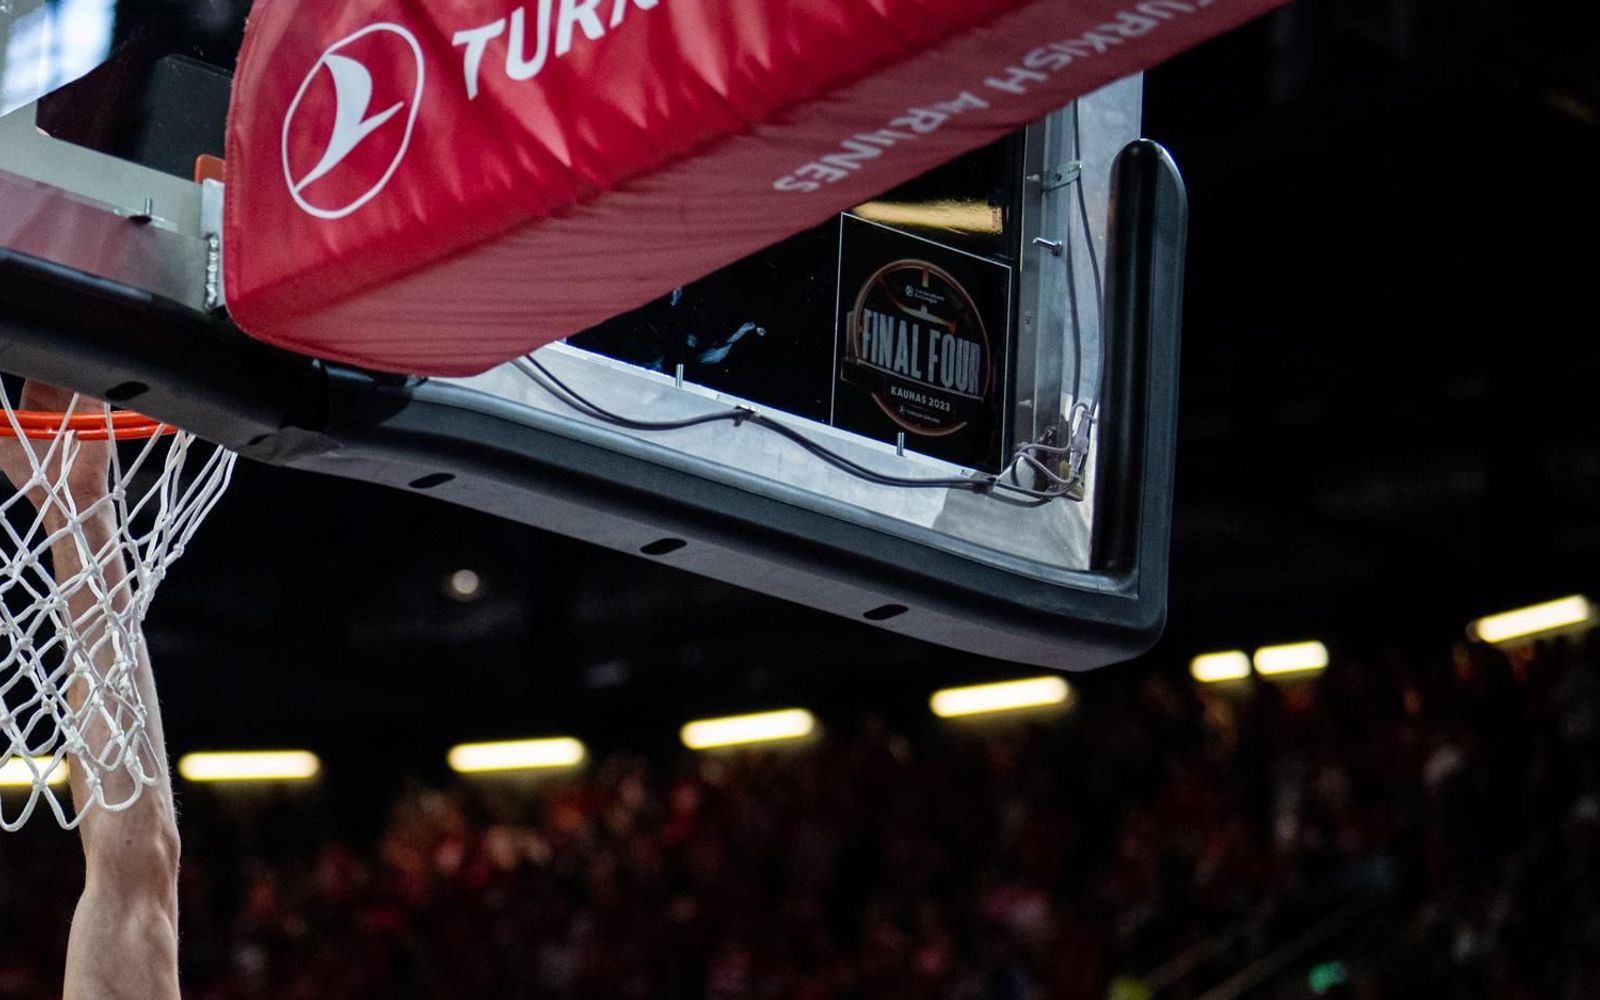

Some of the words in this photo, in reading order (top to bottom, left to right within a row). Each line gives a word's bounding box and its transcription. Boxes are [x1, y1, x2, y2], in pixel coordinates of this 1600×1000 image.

[452, 0, 658, 101] TUR
[986, 0, 1214, 94] URKISH
[862, 308, 922, 379] FINAL
[927, 328, 981, 396] FOUR
[890, 385, 927, 405] KAUNAS
[928, 397, 951, 412] 2023
